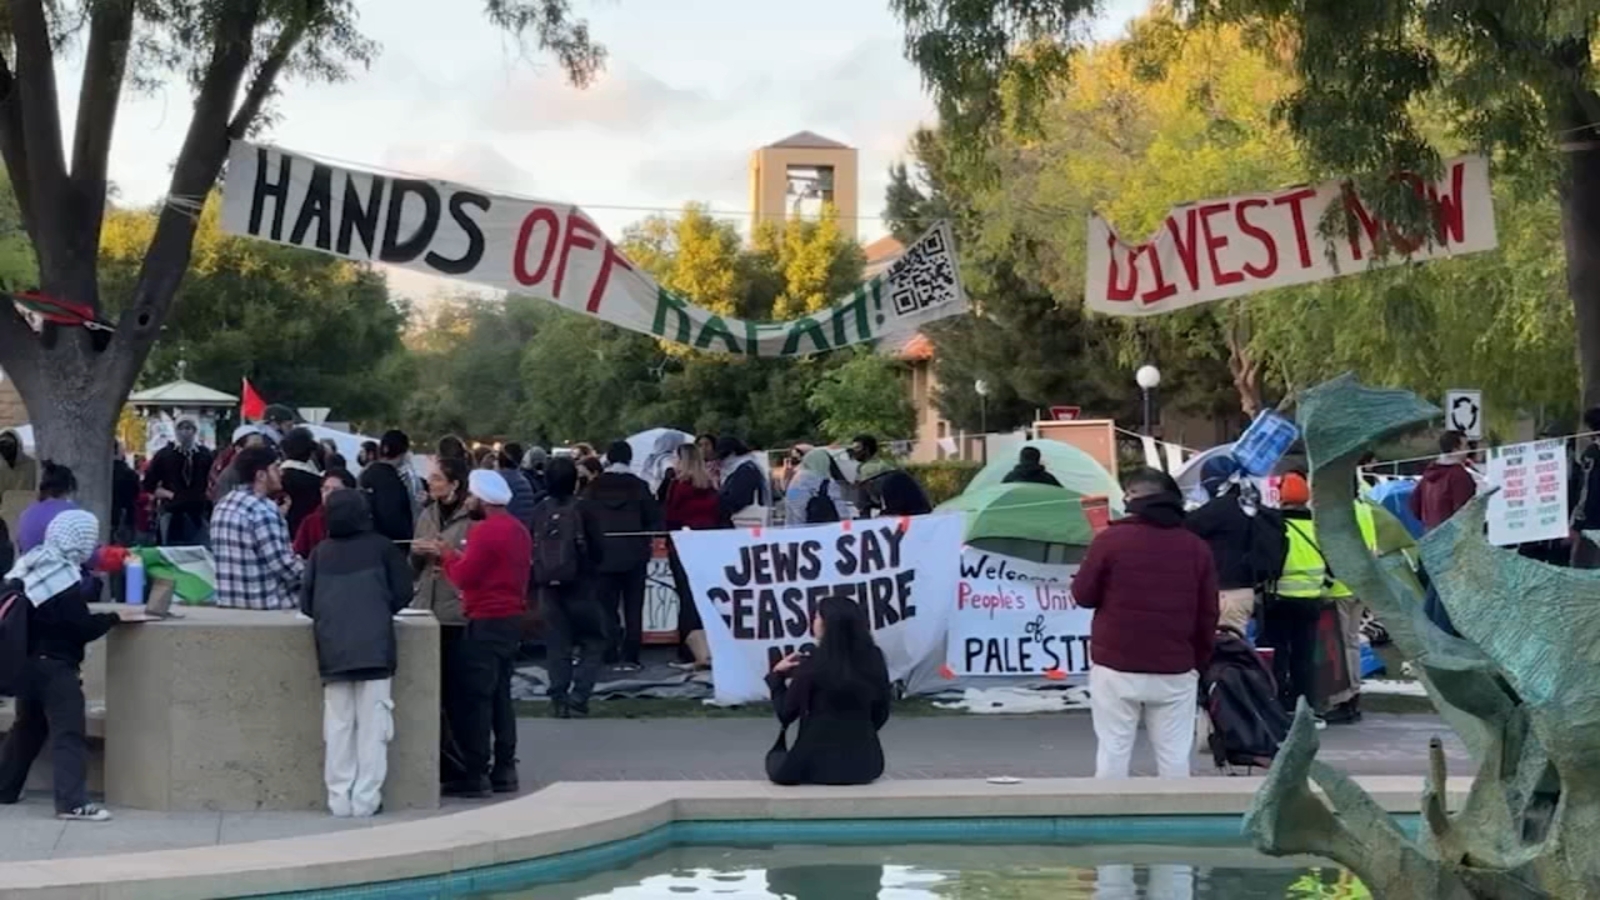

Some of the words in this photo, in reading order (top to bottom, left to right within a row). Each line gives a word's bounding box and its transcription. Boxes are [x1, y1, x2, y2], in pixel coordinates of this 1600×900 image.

[248, 148, 491, 274] HANDS
[513, 207, 634, 314] OFF
[1106, 189, 1317, 304] DIVEST
[724, 541, 821, 586] JEWS
[835, 525, 906, 576] SAY
[958, 581, 1025, 620] People's
[1025, 614, 1046, 643] of
